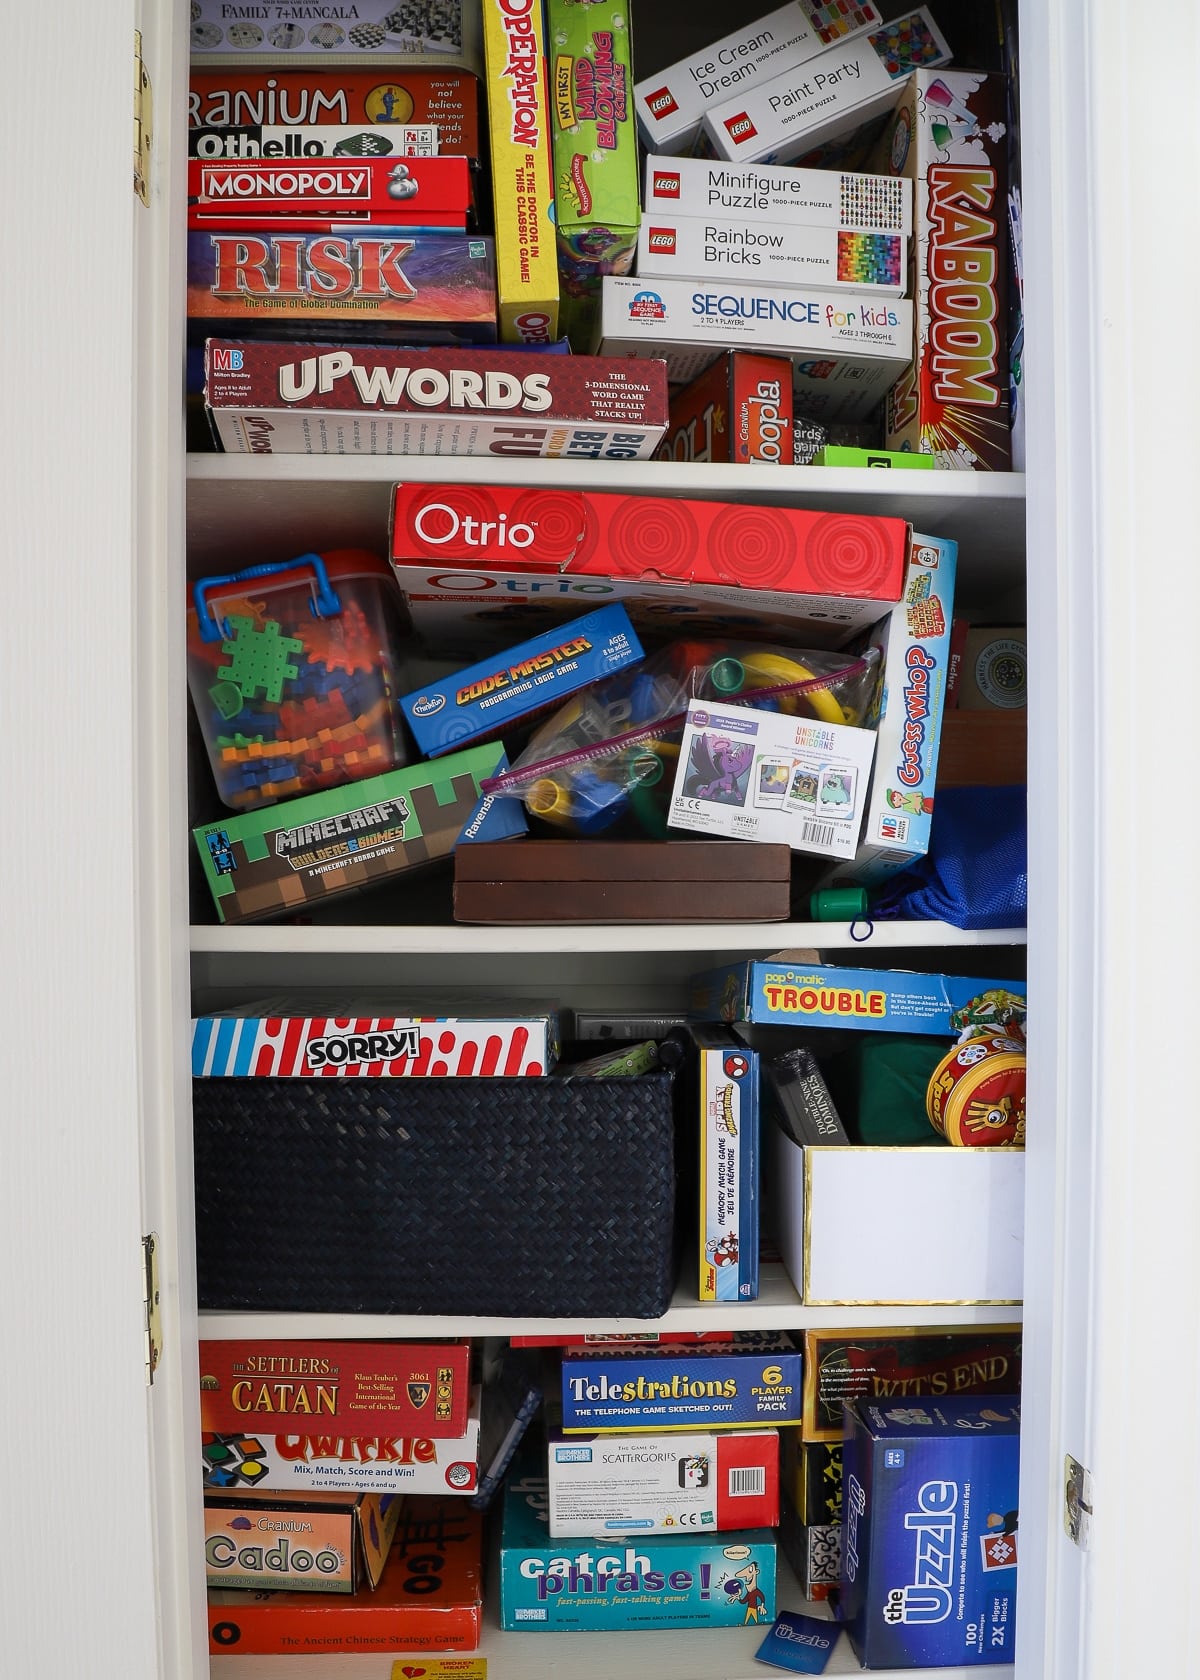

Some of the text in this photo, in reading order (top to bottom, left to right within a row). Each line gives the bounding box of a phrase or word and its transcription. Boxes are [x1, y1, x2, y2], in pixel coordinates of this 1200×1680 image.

[222, 4, 271, 19] FAMILY
[688, 29, 775, 82] Ice Cream
[698, 31, 809, 99] Dream 1000-PIECE PUZZLE
[499, 0, 539, 149] OPERATION
[767, 59, 862, 113] Paint Party
[557, 66, 572, 120] MY FIRST
[575, 57, 596, 120] MIND
[593, 31, 617, 150] BLOWING
[614, 63, 625, 121] SCIENCE
[428, 99, 462, 109] believe
[650, 94, 672, 113] LEGO
[781, 94, 837, 125] 1000-PIECE PUZZLE
[730, 119, 752, 138] LEGO
[197, 134, 324, 157] Othello
[208, 172, 366, 196] MONOPOLY
[654, 177, 679, 192] LEGO
[708, 170, 801, 195] Minifigure
[525, 153, 540, 258] BE THE DOCTOR IN
[708, 189, 833, 210] Puzzle 1000-PIECE PUZZLE
[515, 167, 531, 284] THIS CLASSIC GAME!
[704, 226, 784, 248] Rainbow
[649, 233, 675, 247] LEGO
[704, 245, 830, 265] Bricks 1000-PIECE PUZZLE
[210, 235, 418, 299] RISK
[928, 164, 999, 408] KABOOM
[244, 299, 379, 310] The Game Global Domination
[691, 292, 820, 324] SEQUENCE
[825, 304, 856, 328] for
[719, 318, 745, 327] PLAYERS
[860, 331, 888, 341] THROUGH
[213, 348, 245, 371] MB
[279, 350, 554, 412] UPWORDS
[584, 381, 651, 392] 3-DIMENSIONAL
[590, 400, 646, 410] THAT REALLY
[591, 391, 645, 401] WORD GAME
[594, 410, 627, 419] STACKS
[546, 429, 569, 450] WORD
[414, 503, 536, 548] Otrio
[923, 551, 932, 564] 6+
[427, 573, 615, 594] Otrio
[608, 633, 626, 646] AGES
[614, 640, 630, 652] adult
[456, 636, 593, 707] CODE MASTER
[947, 654, 961, 690] Euchre
[479, 661, 579, 711] PROGRAMMING LOGIC GAME
[905, 647, 935, 721] Who?
[795, 736, 834, 751] UNICORNS
[796, 726, 836, 742] UNSTABLE
[897, 720, 925, 785] Guess
[277, 798, 408, 853] MINECRAFT
[881, 817, 897, 839] MB
[289, 825, 404, 868] BUILDERS BIOMES
[314, 845, 396, 875] MINECRAFT BOARD GAME
[764, 973, 826, 985] pop matic
[766, 986, 884, 1016] TROUBLE
[307, 1028, 419, 1066] SORRY!
[807, 1074, 839, 1135] DOMINOES
[934, 1071, 955, 1122] Spot
[716, 1086, 729, 1132] SPIDEY
[717, 1137, 726, 1226] MEMORY MATCH GAME
[247, 1355, 331, 1376] SETTLERS
[409, 1373, 430, 1381] 3061
[761, 1365, 783, 1384] 6
[872, 1355, 1009, 1398] WIT'S END
[231, 1380, 341, 1416] CATAN
[355, 1393, 396, 1401] International
[358, 1383, 394, 1392] Best-Selling
[569, 1375, 737, 1402] Telestrations
[751, 1385, 793, 1396] PLAYER
[758, 1395, 785, 1403] FAMILY
[349, 1402, 367, 1410] Game
[575, 1404, 733, 1417] THE TELEPHONE GAME SKETCHED OUT!
[756, 1402, 787, 1412] PACK
[274, 1434, 438, 1465] Qwirkle
[602, 1453, 677, 1464] SCATTERGORIES
[294, 1465, 416, 1478] Mix, Match, Score and Win!
[328, 1480, 351, 1489] Players
[205, 1535, 339, 1574] Cadoo
[519, 1548, 652, 1579] catch
[903, 1480, 959, 1624] Uzzle
[402, 1555, 446, 1595] GO
[537, 1564, 712, 1600] phrase!
[556, 1594, 690, 1608] fast-passing, fast-talking game!
[884, 1590, 904, 1623] the
[992, 1597, 1000, 1622] Bigger
[1000, 1597, 1009, 1622] Blocks
[280, 1635, 465, 1646] The Ancient Chinese Strategy Game
[966, 1623, 978, 1646] 100
[992, 1625, 1005, 1646] 2X
